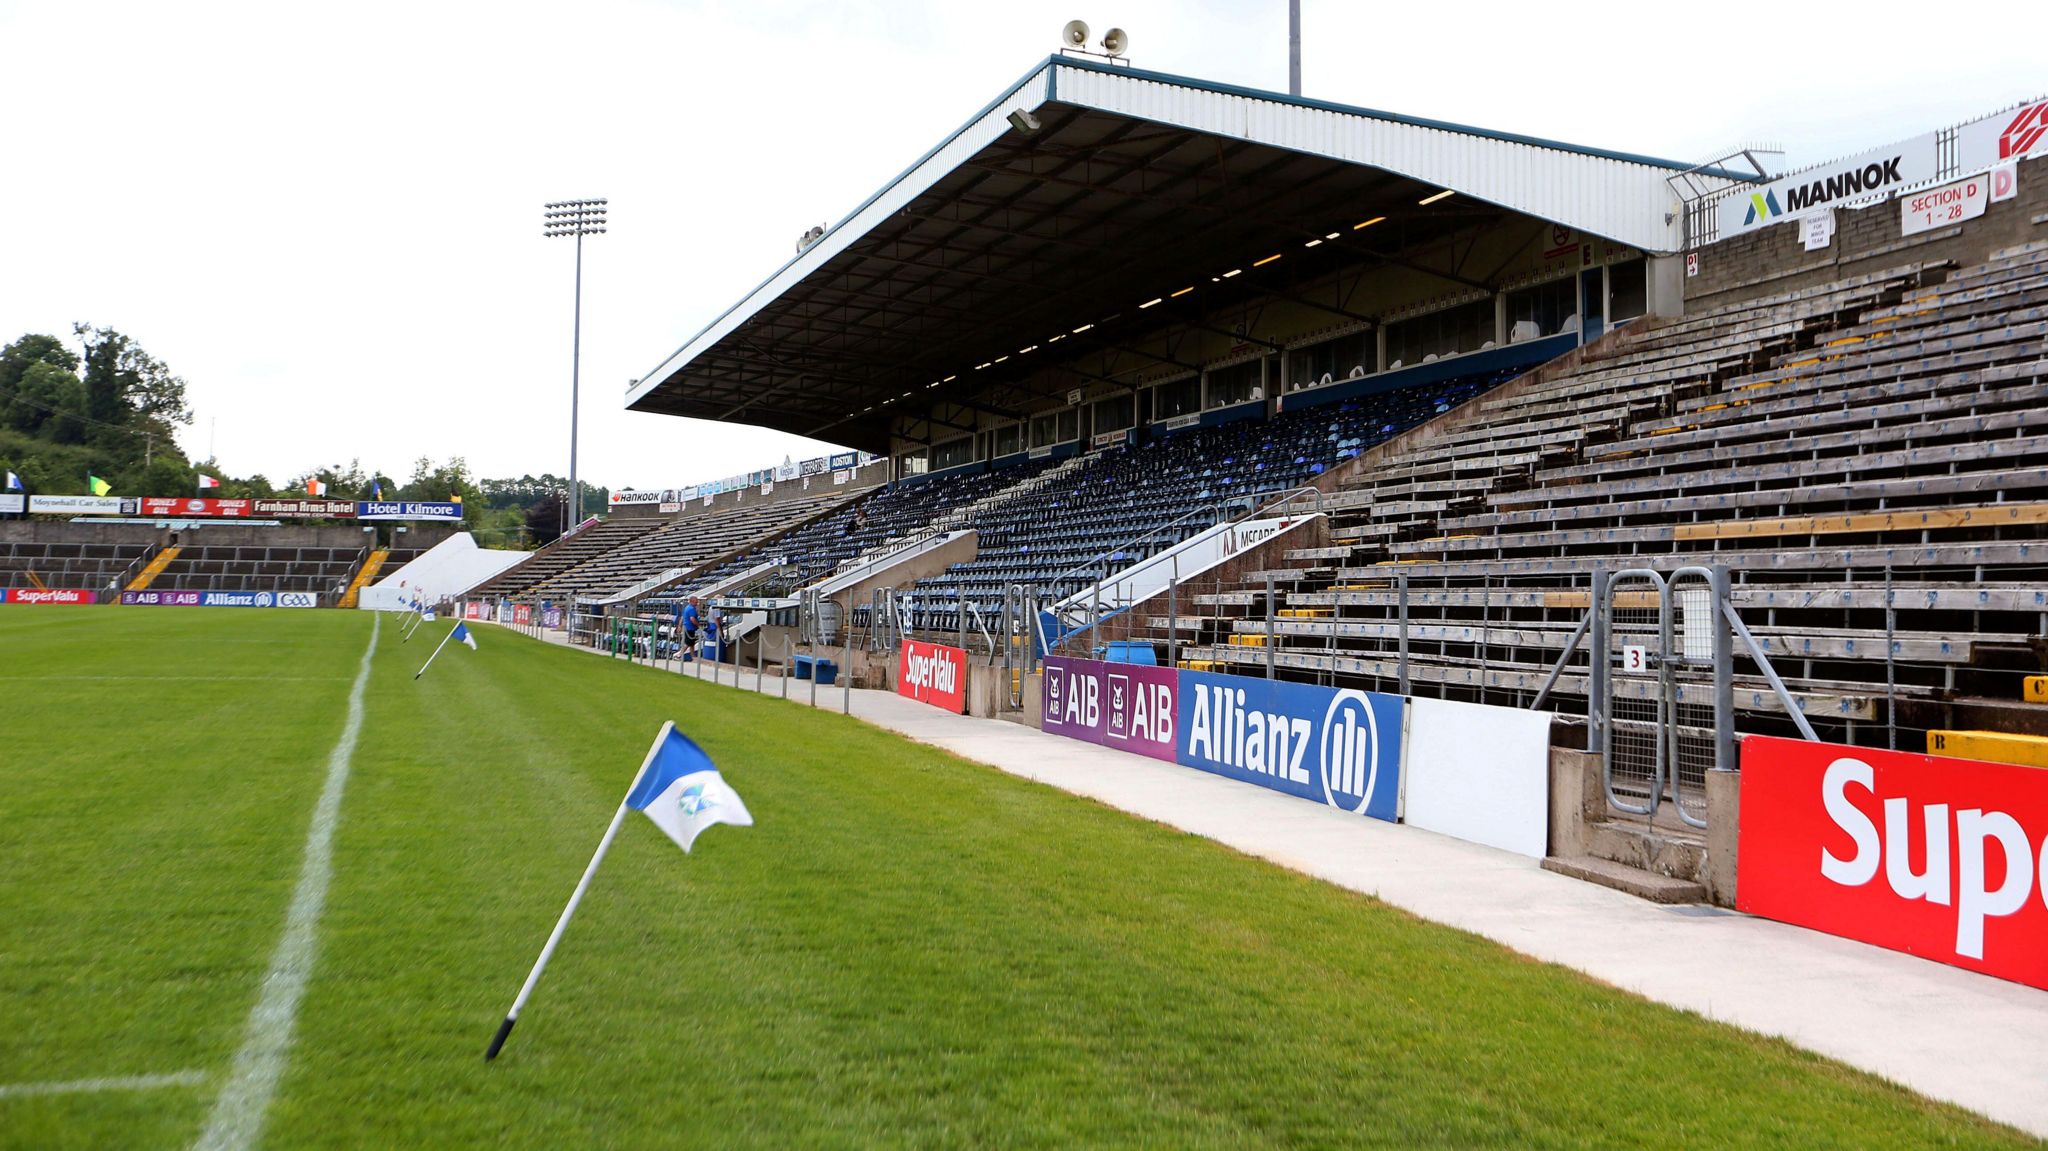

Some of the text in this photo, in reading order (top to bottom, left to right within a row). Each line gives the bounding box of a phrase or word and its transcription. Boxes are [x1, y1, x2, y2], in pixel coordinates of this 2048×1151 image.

[1788, 155, 1902, 212] MANNOK
[1995, 169, 2012, 197] D
[1911, 183, 1977, 213] SECTION D
[1926, 213, 1931, 225] 1
[1948, 204, 1962, 220] 28
[1688, 254, 1697, 265] D1
[79, 499, 93, 507] Car
[96, 499, 117, 507] Sales
[254, 500, 354, 513] Farnham Arms Hotel
[367, 503, 453, 514] Hotel Kilmore
[16, 590, 79, 604] SuperValu
[136, 593, 199, 604] AIB AIB
[205, 593, 253, 605] Allianz
[1631, 649, 1640, 668] 3
[905, 644, 956, 697] SuperValu
[1049, 700, 1060, 715] AIB
[1065, 673, 1173, 744] AIB AIB
[1111, 711, 1123, 729] AIB
[1188, 683, 1311, 785] Allianz
[1820, 757, 2048, 961] Sup
